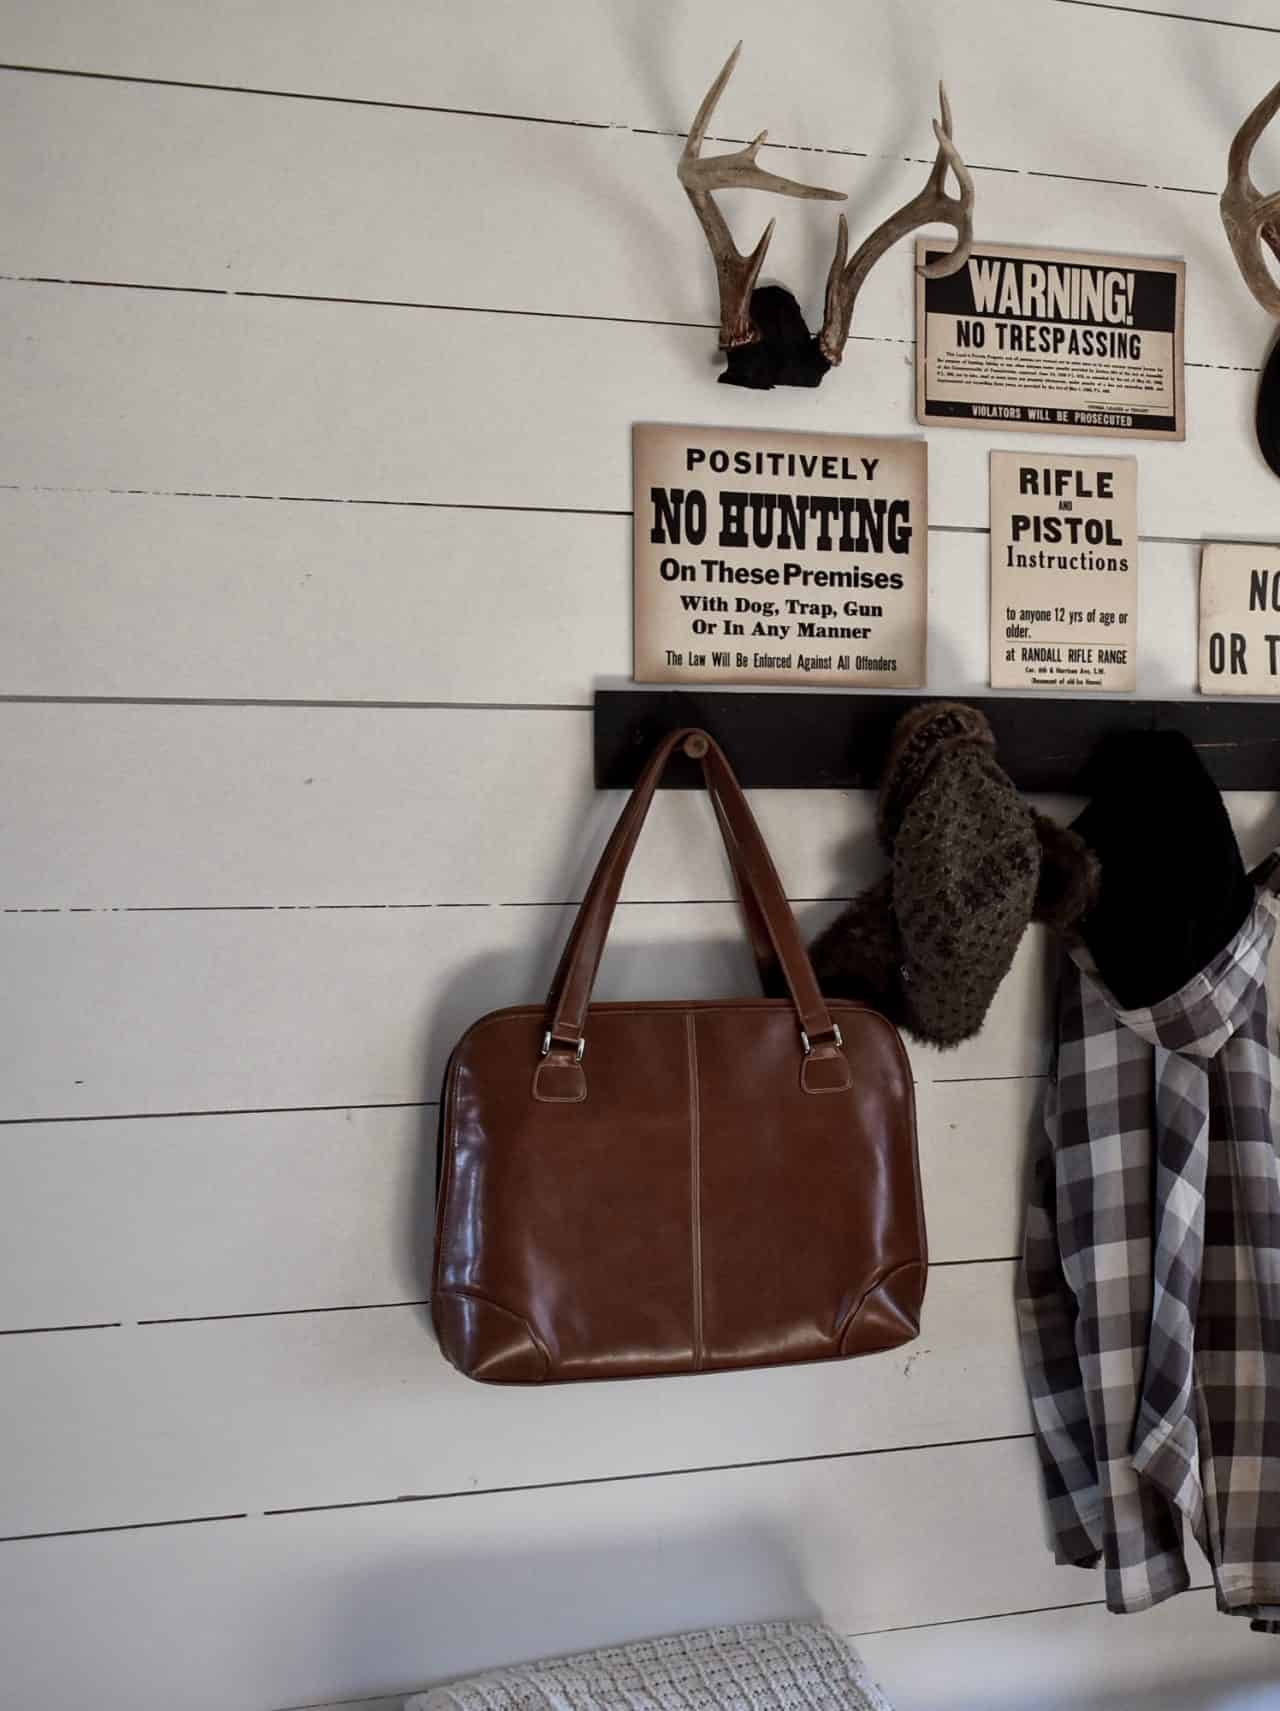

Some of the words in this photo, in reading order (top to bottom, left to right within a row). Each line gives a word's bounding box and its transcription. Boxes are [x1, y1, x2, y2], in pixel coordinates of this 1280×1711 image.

[968, 258, 1136, 326] WARNING!
[956, 320, 985, 348] NO
[995, 323, 1142, 360] TRESPASSING
[972, 405, 1022, 420] VIOLATORS
[1028, 408, 1050, 421] WILL
[1056, 411, 1069, 422] BE
[1074, 412, 1133, 427] PROSECUTED
[686, 448, 880, 481] POSITIVELY
[1019, 467, 1114, 499] RIFLE
[1058, 500, 1073, 511] AND
[650, 487, 707, 545] NO
[718, 491, 913, 554] HUNTING
[1011, 514, 1123, 546] PISTOL
[1007, 545, 1129, 572] Instructions
[660, 558, 696, 581] On
[701, 559, 779, 585] These
[783, 563, 904, 590] Premises
[680, 595, 728, 613] With
[735, 597, 780, 617] Dog,
[785, 599, 837, 618] Trap,
[843, 601, 883, 617] Gun
[1006, 606, 1016, 621] to
[1019, 608, 1051, 625] anyone
[1055, 607, 1065, 622] 12
[1069, 610, 1083, 625] yrs
[1087, 607, 1096, 623] of
[1099, 611, 1115, 626] age
[1119, 612, 1129, 624] or
[692, 619, 717, 635] Or
[723, 620, 744, 636] In
[751, 621, 790, 640] Any
[797, 622, 871, 640] Manner
[1006, 624, 1032, 639] older.
[665, 650, 682, 667] The
[688, 651, 706, 667] Law
[712, 651, 730, 668] Will
[736, 652, 748, 668] Be
[753, 653, 792, 670] Enforced
[797, 654, 832, 672] Against
[837, 655, 850, 671] All
[855, 655, 897, 672] Offenders
[1005, 648, 1015, 662] at
[1021, 647, 1062, 662] RANDALL
[1068, 648, 1093, 663] RIFLE
[1098, 649, 1127, 664] RANGE
[1208, 632, 1249, 675] OR
